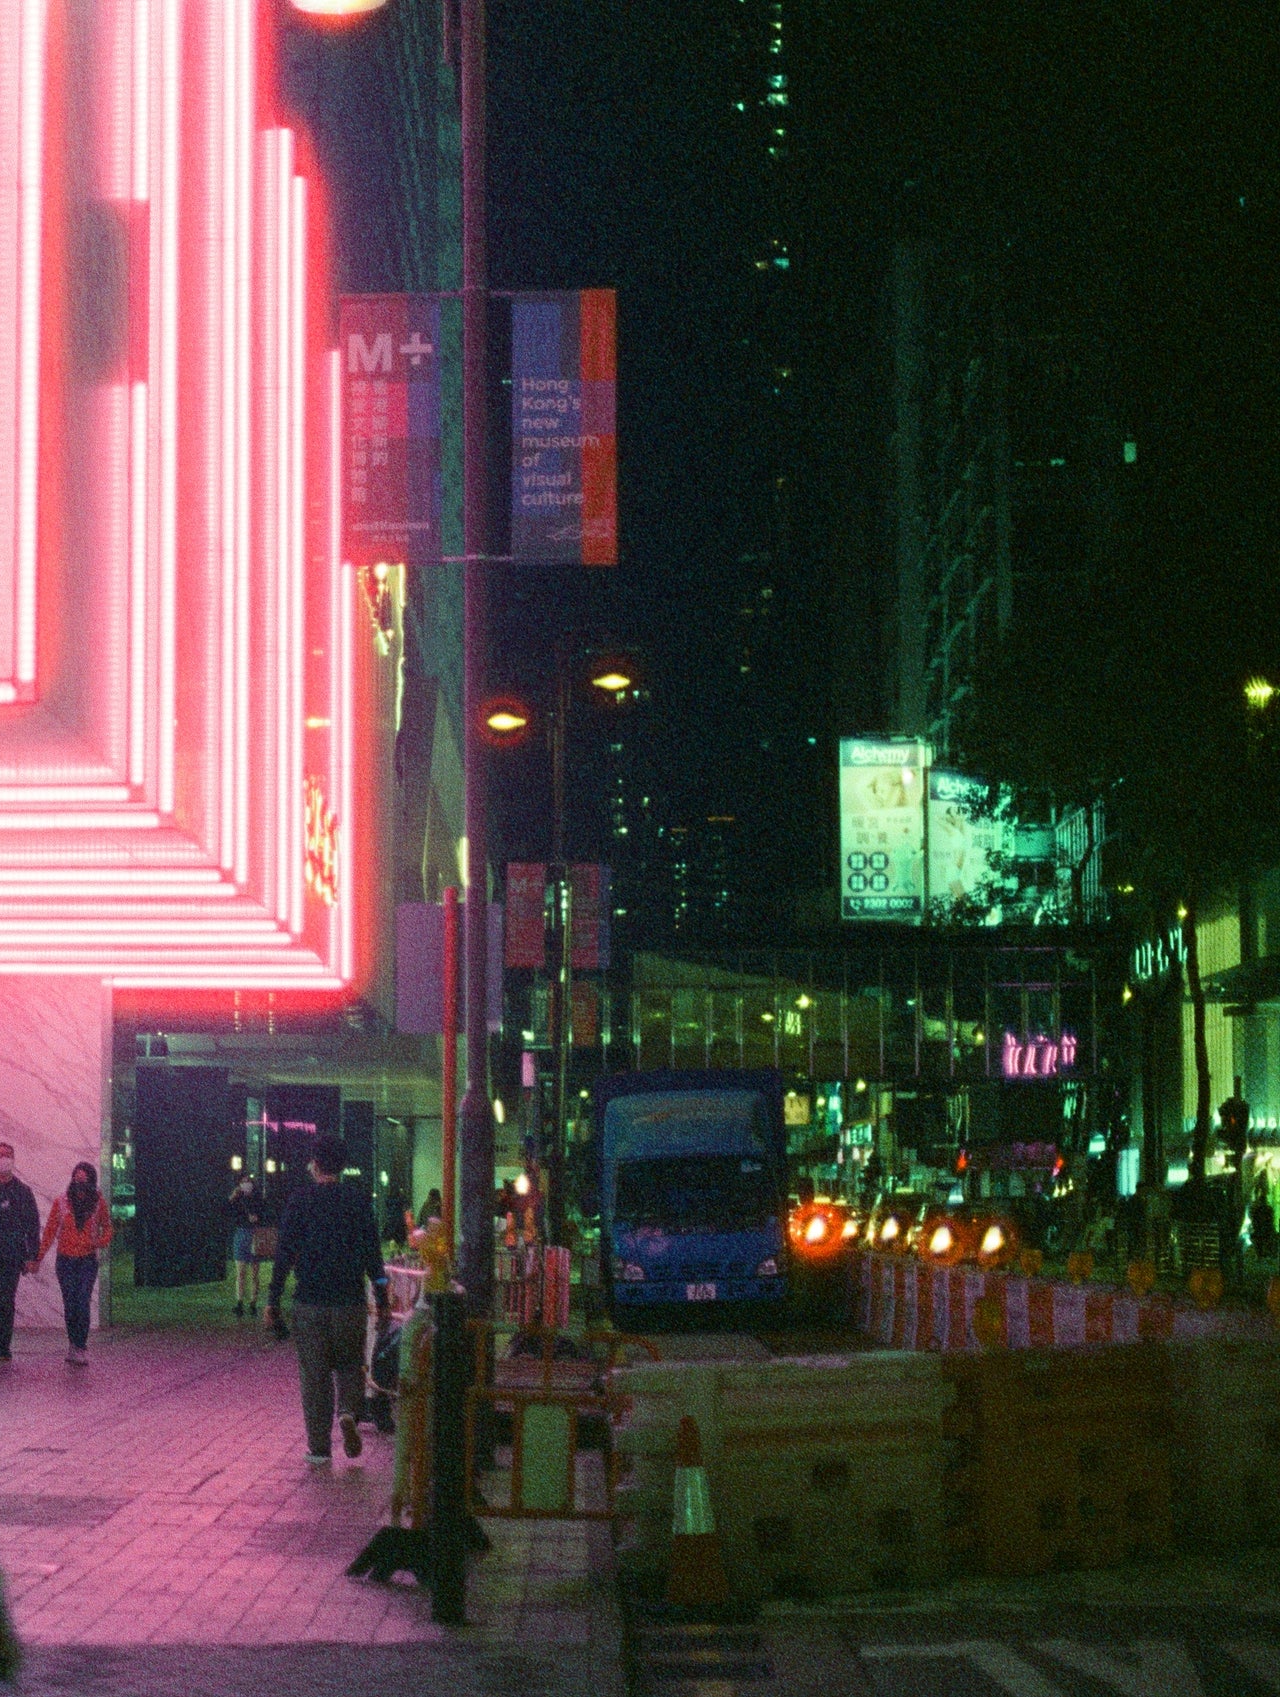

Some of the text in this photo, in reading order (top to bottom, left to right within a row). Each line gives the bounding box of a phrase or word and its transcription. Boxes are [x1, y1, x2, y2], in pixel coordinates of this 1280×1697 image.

[348, 332, 433, 373] M+
[522, 378, 569, 393] Hong
[522, 396, 581, 413] Kong's
[522, 418, 560, 429] new
[522, 435, 601, 449] museum
[522, 453, 541, 467] of
[522, 472, 573, 486] visual
[522, 491, 584, 505] culture
